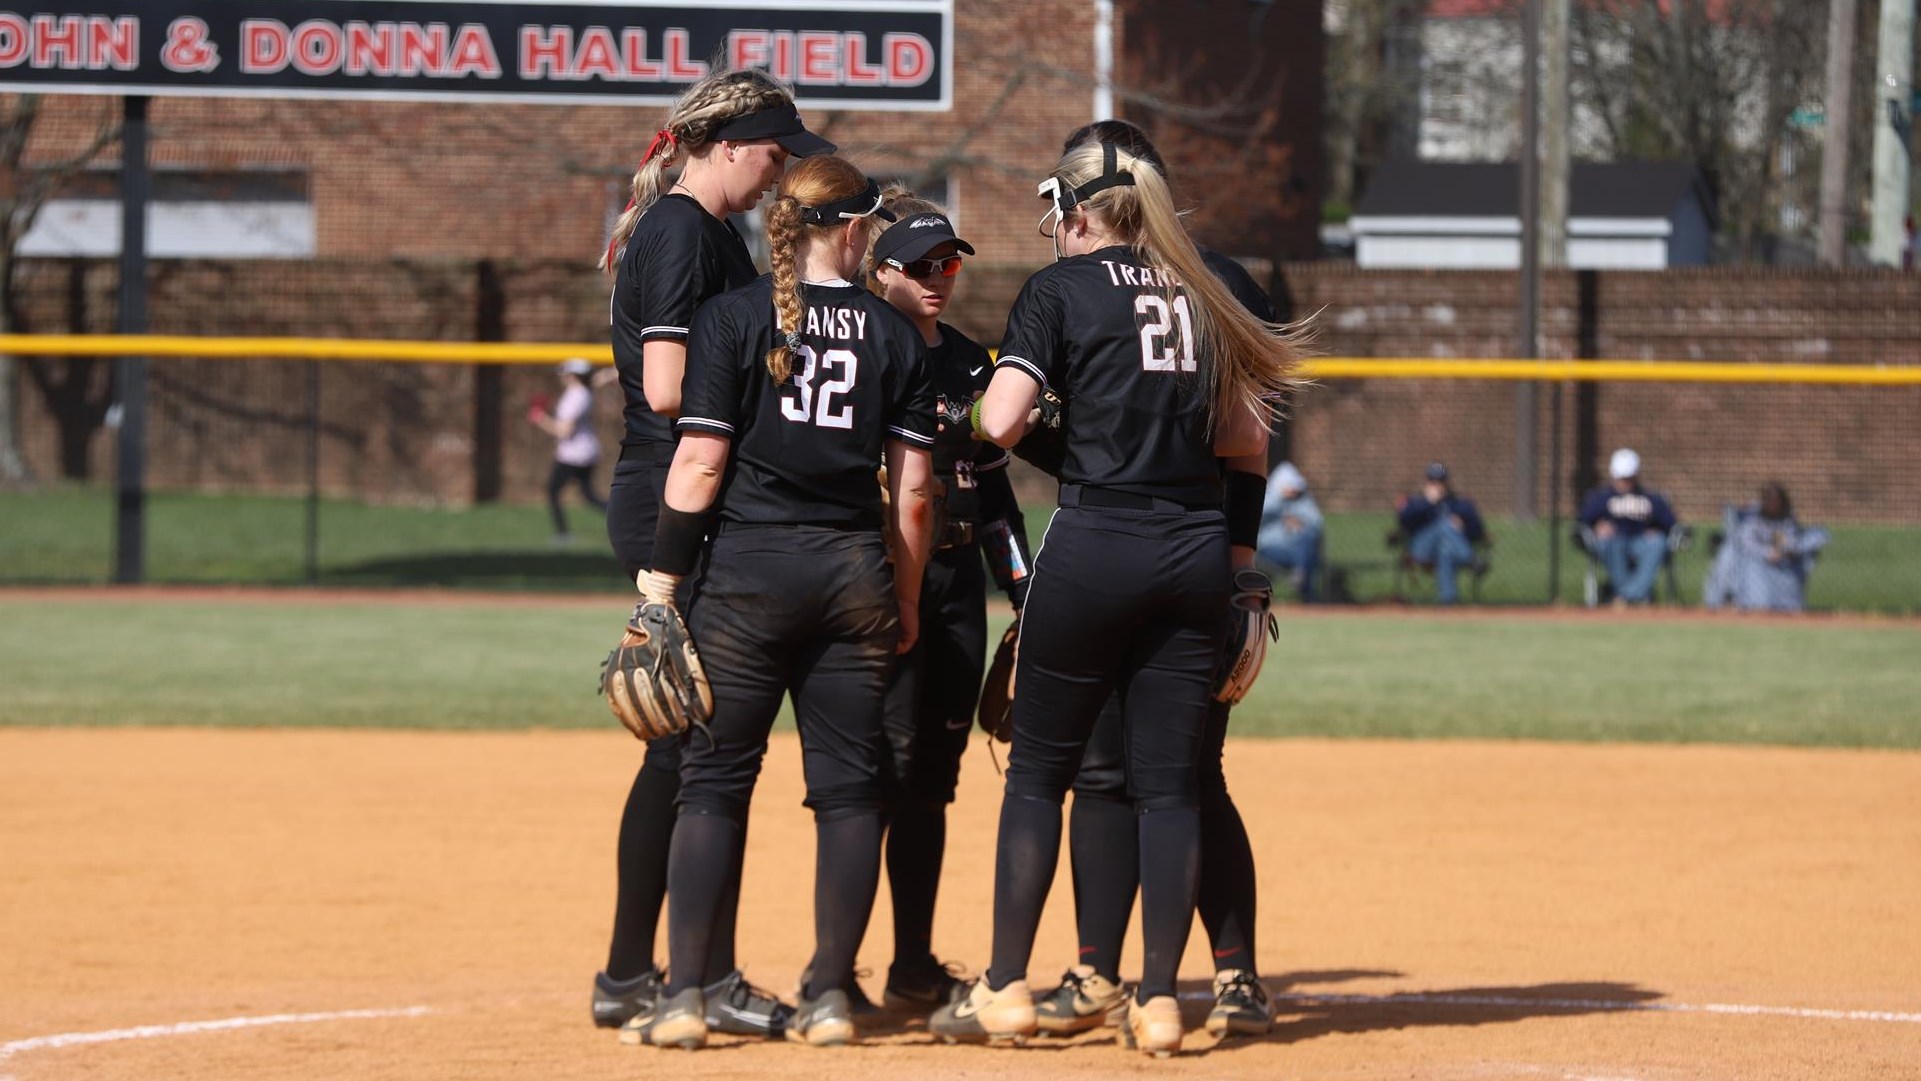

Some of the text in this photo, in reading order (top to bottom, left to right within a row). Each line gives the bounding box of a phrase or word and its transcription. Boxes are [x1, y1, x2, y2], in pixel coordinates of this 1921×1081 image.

[160, 15, 222, 73] &
[239, 18, 503, 79] DONNA
[517, 24, 708, 82] HALL
[727, 29, 936, 87] FIELD
[1101, 260, 1184, 287] TRAN
[776, 305, 867, 340] ANSY
[1134, 294, 1197, 371] 21
[781, 344, 857, 429] 32
